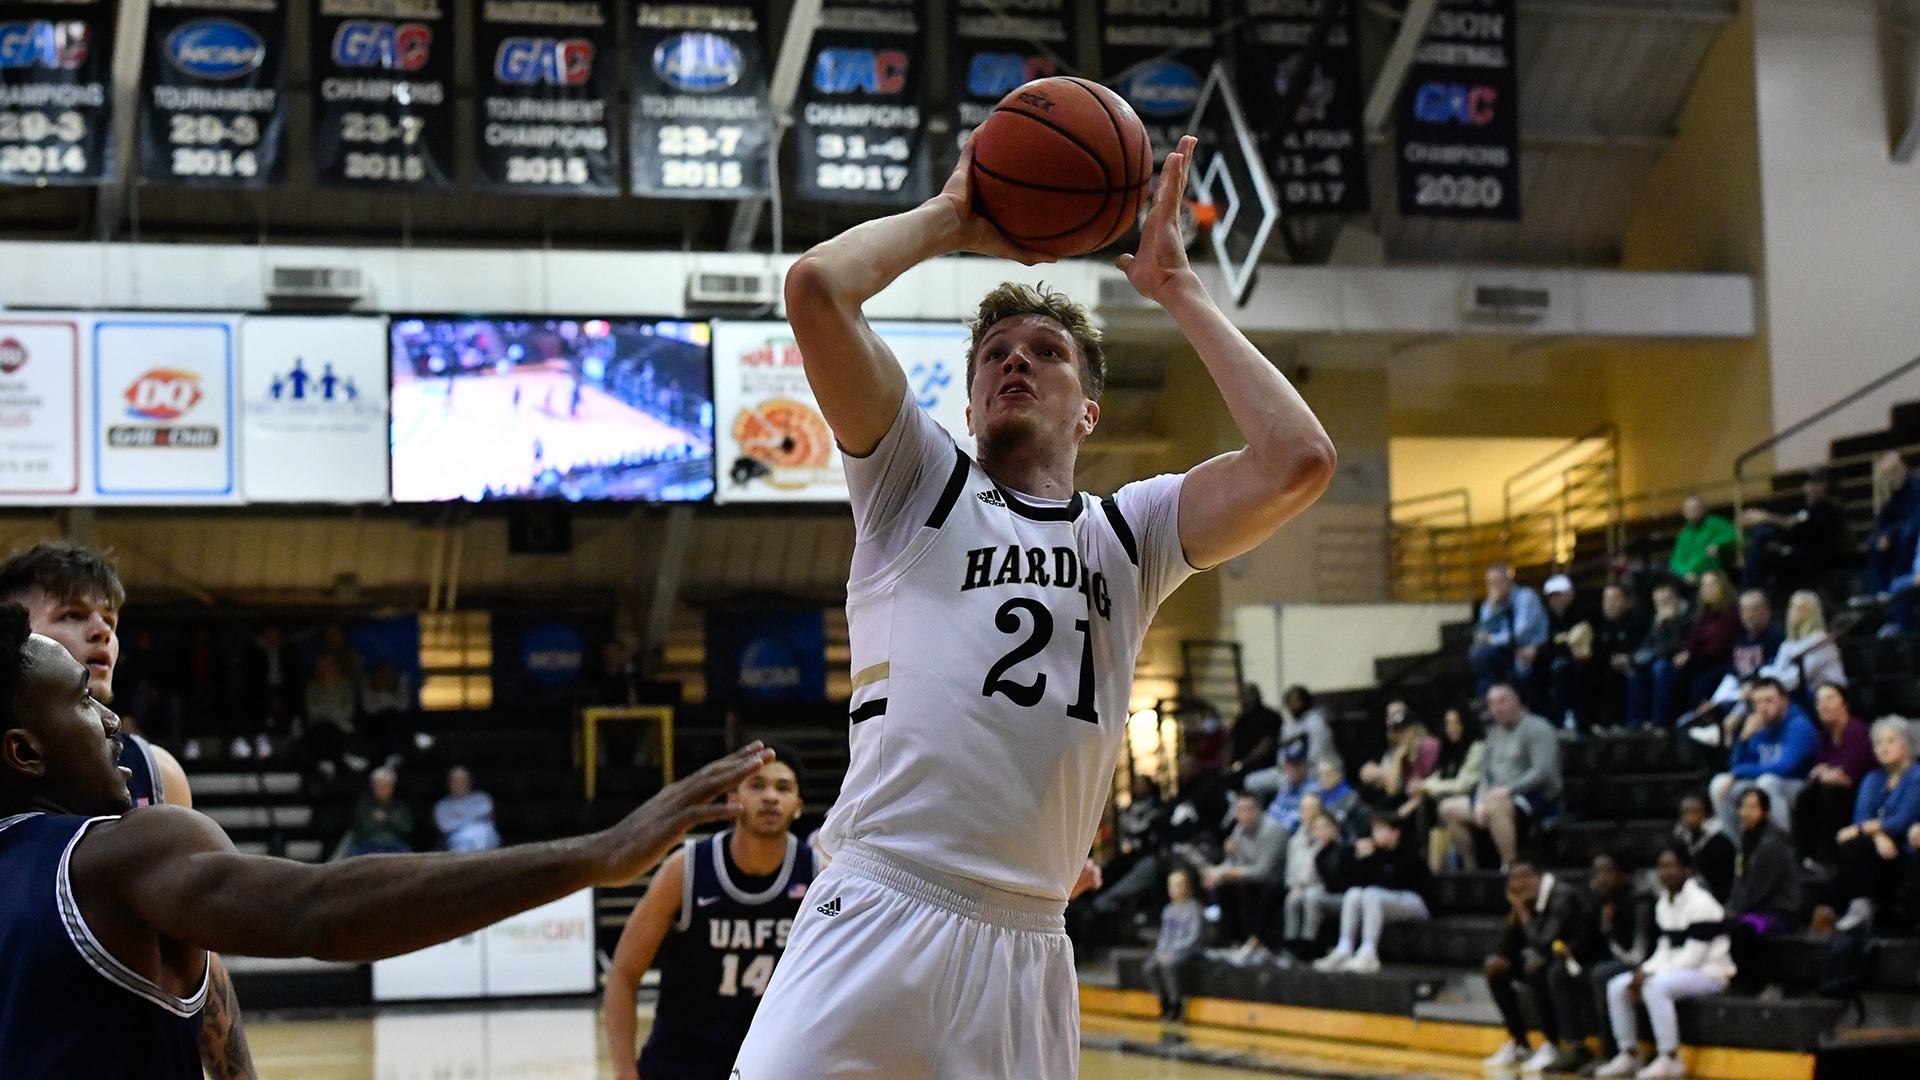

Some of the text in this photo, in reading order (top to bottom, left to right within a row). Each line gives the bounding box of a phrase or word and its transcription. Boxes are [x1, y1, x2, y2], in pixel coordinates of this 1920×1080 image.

[332, 20, 434, 71] GAC
[494, 37, 594, 86] GAC
[321, 78, 444, 105] CHAMPONS
[1413, 82, 1498, 125] GAC
[804, 103, 920, 130] CHAMPIONS
[485, 122, 608, 151] CHAMPIONS
[658, 125, 744, 156] 23-7
[0, 145, 86, 173] 2014
[172, 148, 258, 176] 2014
[506, 156, 589, 184] 2015
[662, 160, 743, 188] 2015
[816, 163, 908, 191] 2017
[1286, 181, 1346, 202] 017
[1416, 174, 1503, 208] 2020
[134, 378, 194, 412] DQ
[976, 492, 1006, 508] adidas
[961, 544, 1112, 622] HARDIG
[982, 596, 1100, 725] 21
[709, 918, 794, 949] UAFS
[717, 952, 775, 998] 14
